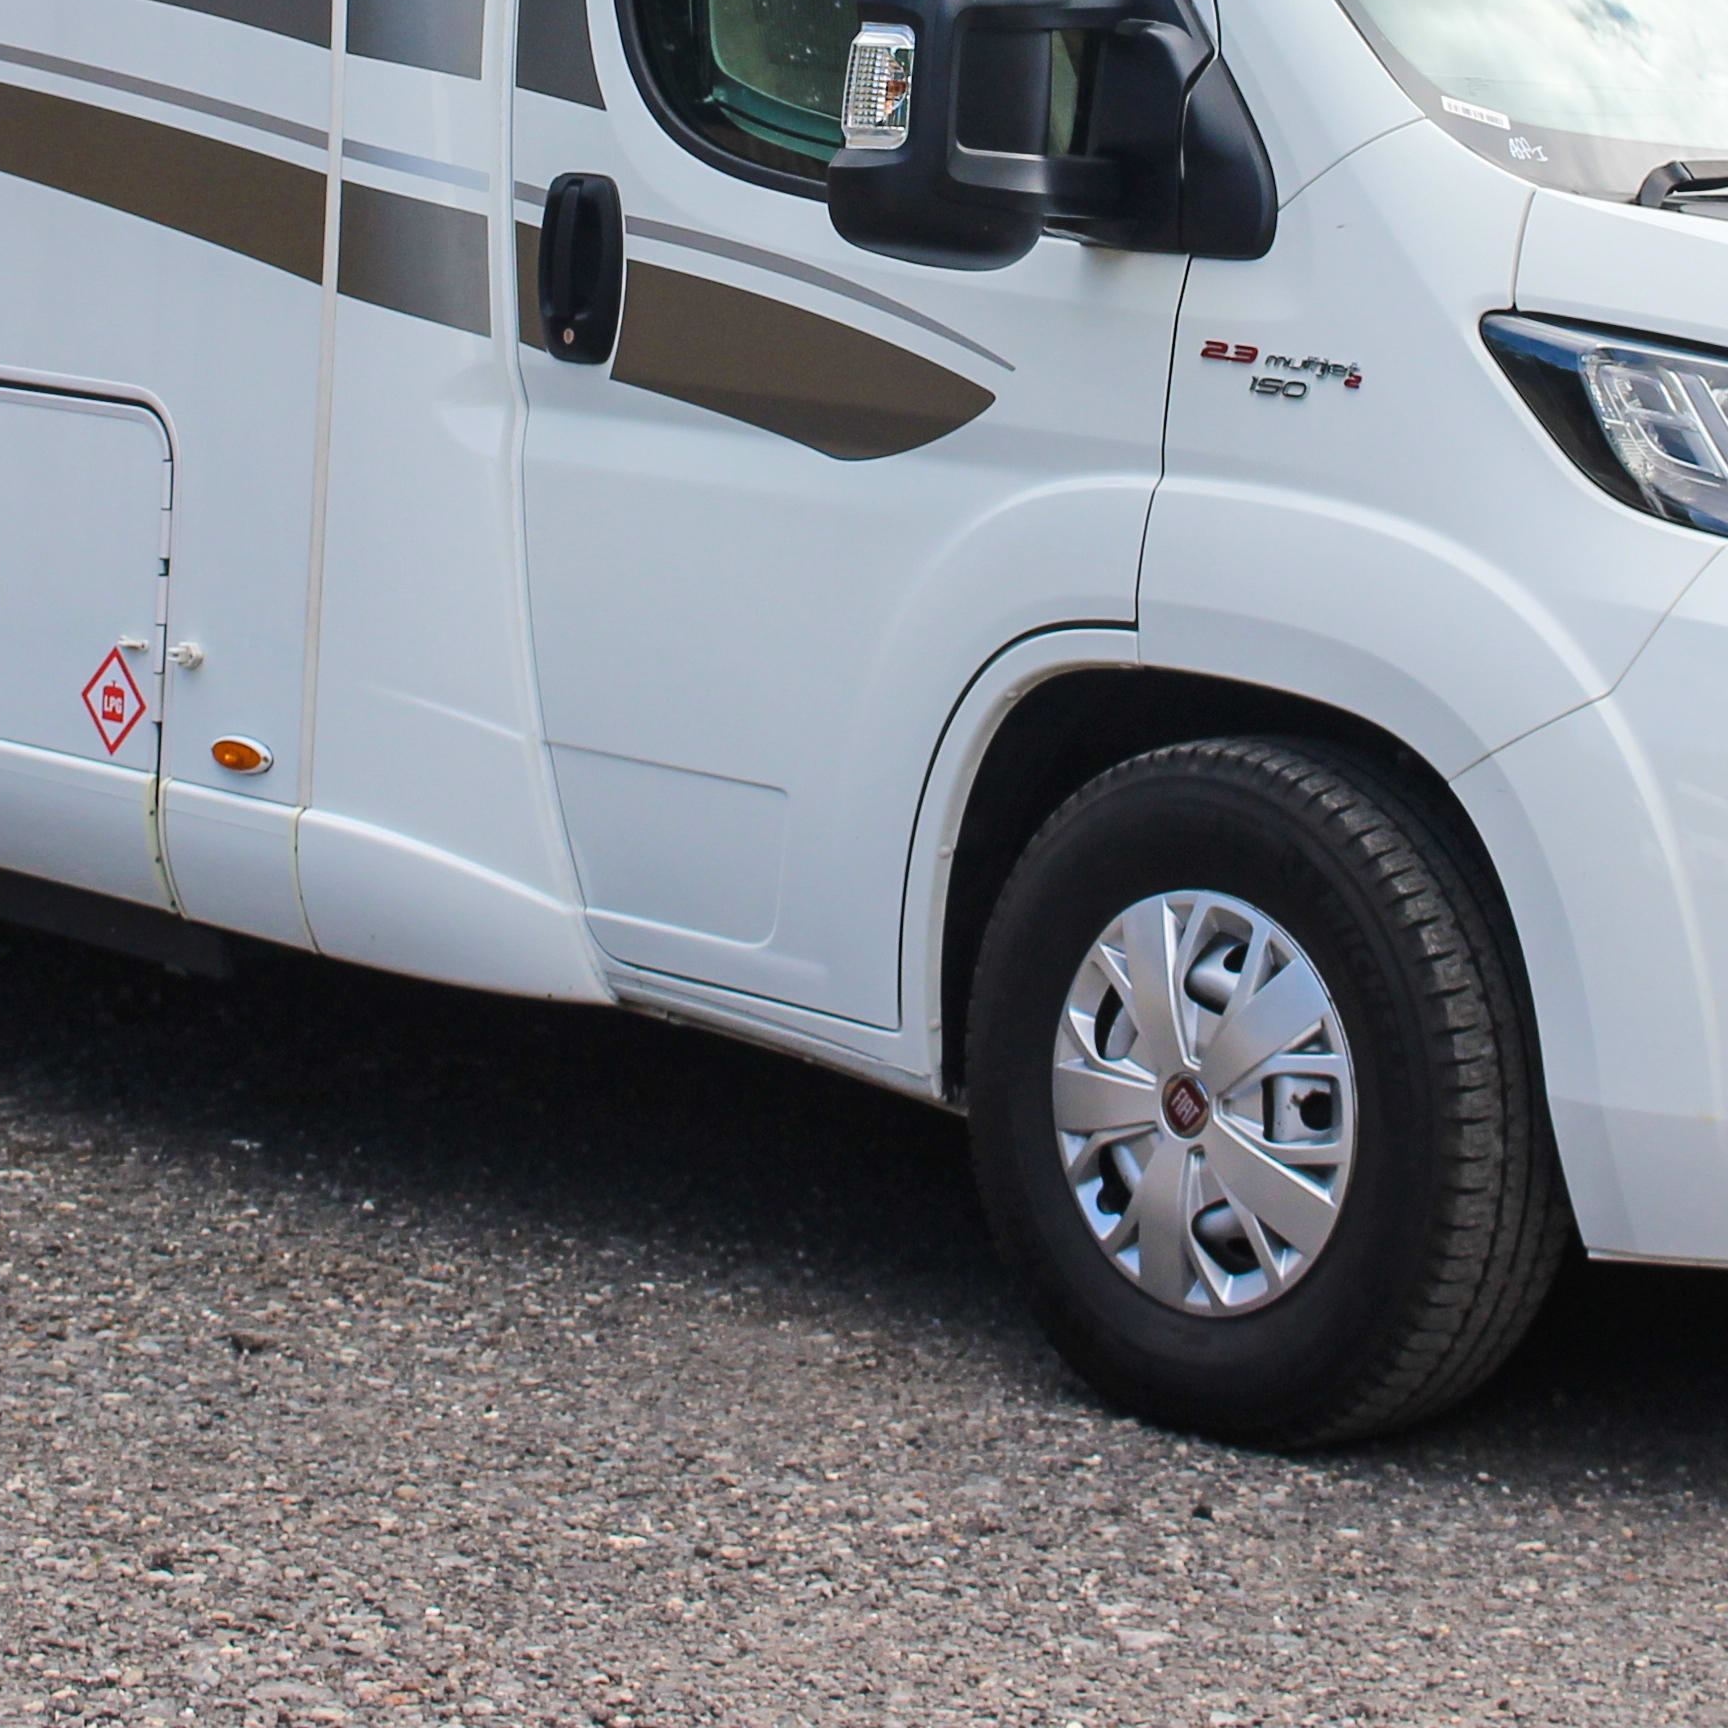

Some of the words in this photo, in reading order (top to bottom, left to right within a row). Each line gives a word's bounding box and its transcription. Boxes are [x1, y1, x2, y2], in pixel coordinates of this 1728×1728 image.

[1200, 340, 1259, 364] 2.3
[1249, 376, 1308, 399] 150
[103, 695, 123, 714] LPG
[1171, 1087, 1200, 1126] FIAT
